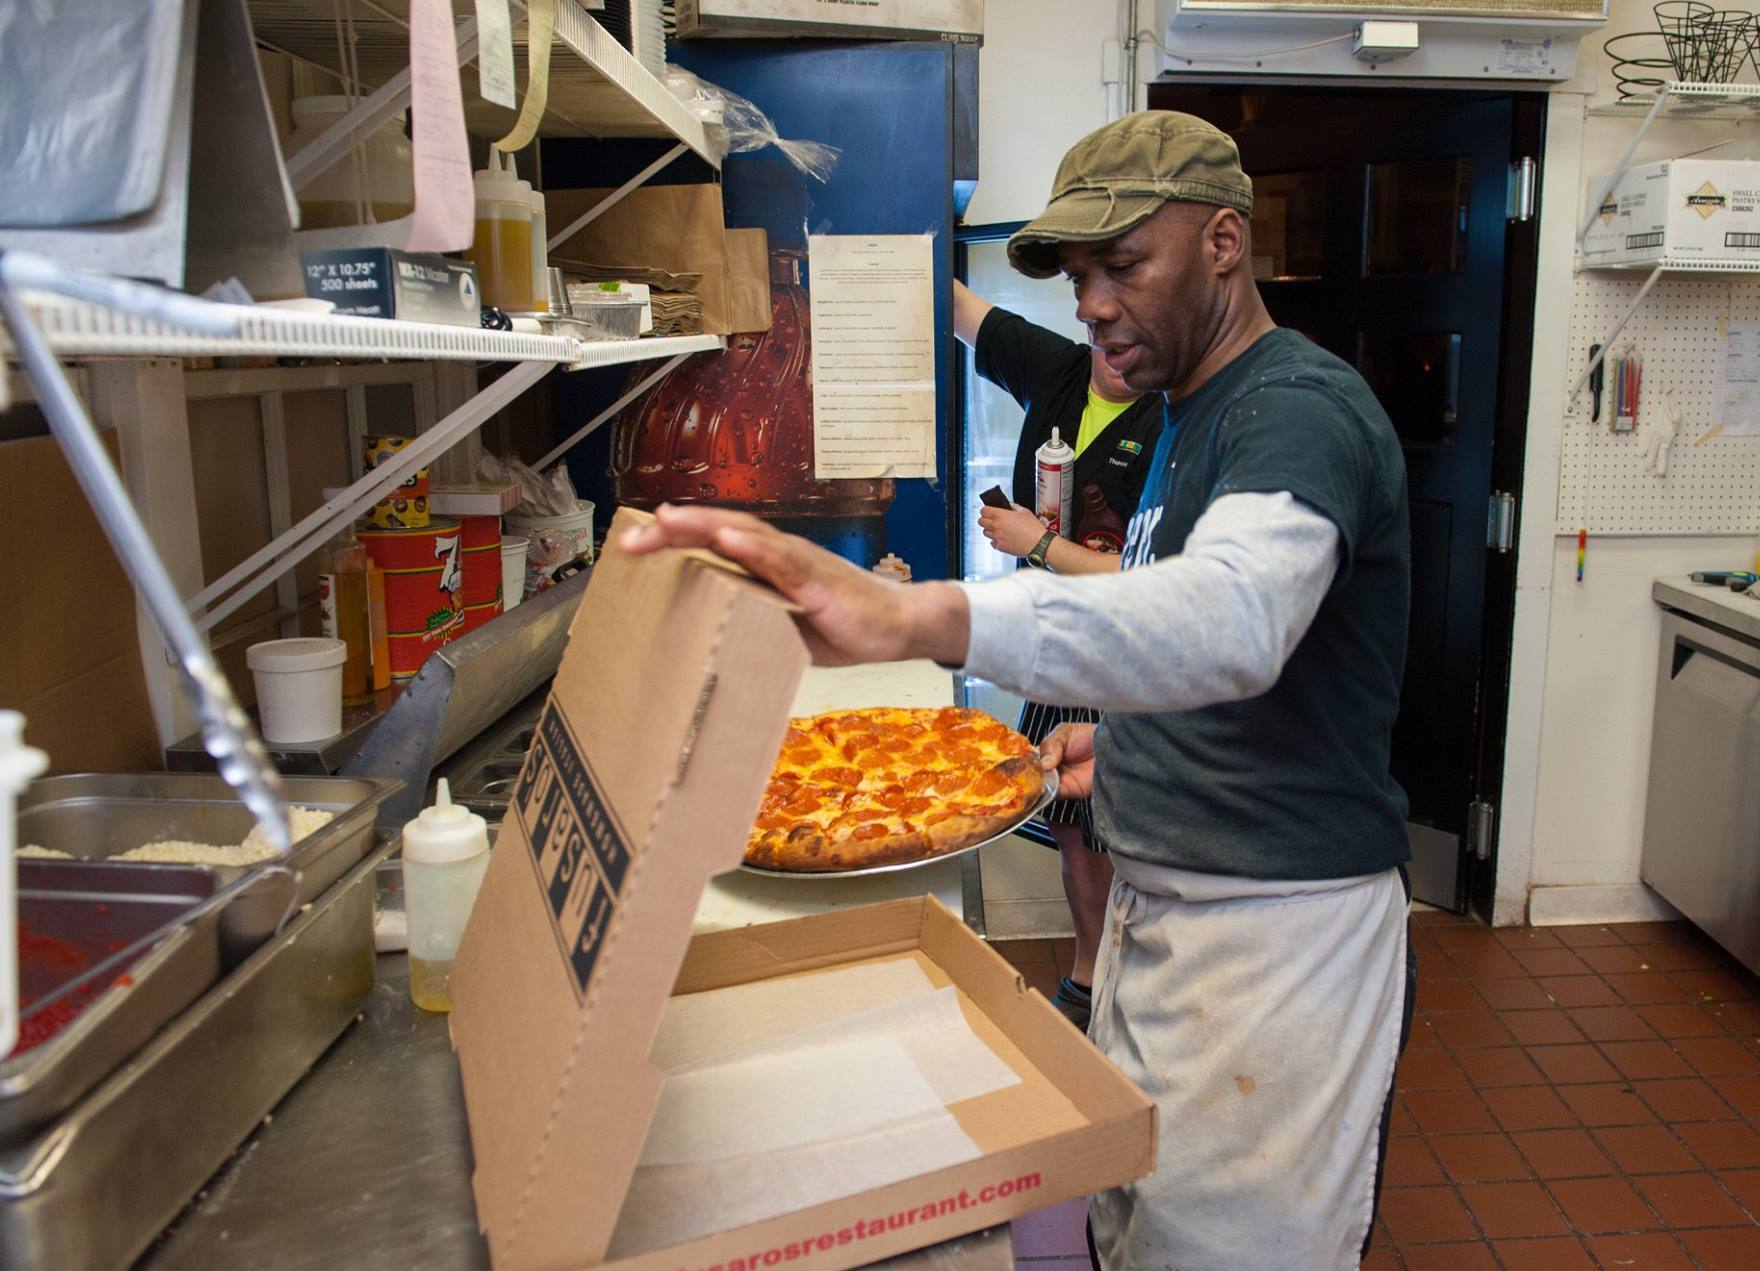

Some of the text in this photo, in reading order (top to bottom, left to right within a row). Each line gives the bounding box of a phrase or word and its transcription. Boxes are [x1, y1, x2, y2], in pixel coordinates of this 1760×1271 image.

[941, 33, 960, 42] CLING
[320, 278, 378, 291] 500 sheets
[434, 535, 461, 592] 7
[673, 1171, 1042, 1271] arosrestaurant.com
